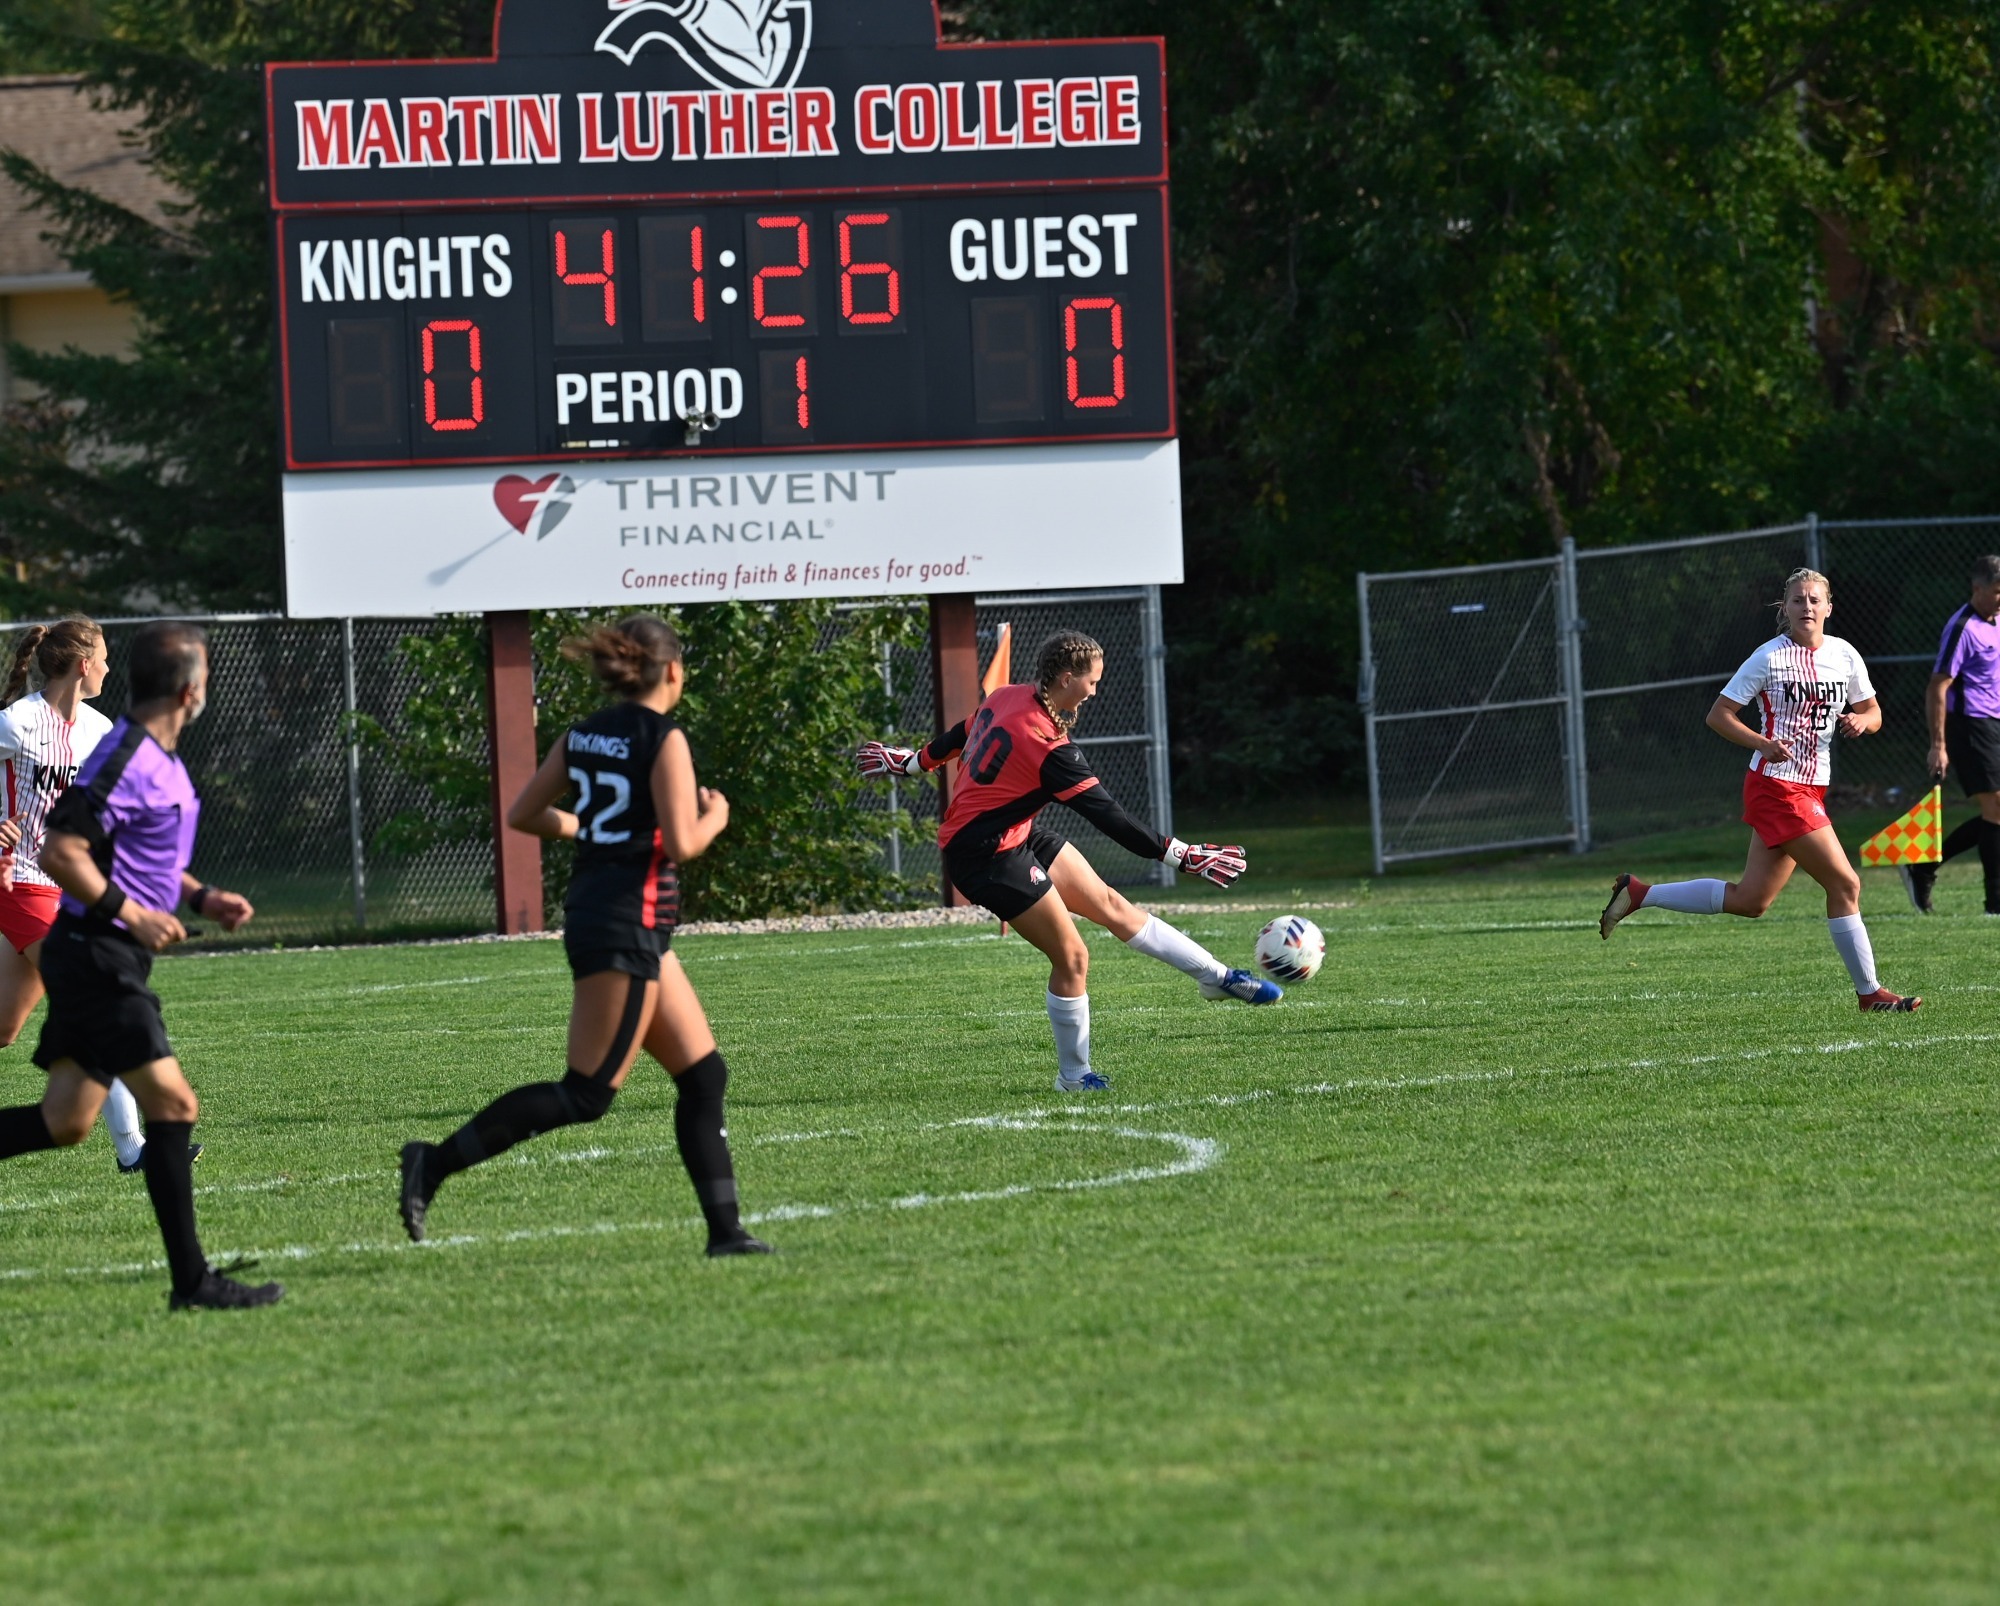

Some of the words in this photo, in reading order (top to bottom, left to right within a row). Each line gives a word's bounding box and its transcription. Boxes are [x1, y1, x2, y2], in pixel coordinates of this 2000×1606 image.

[294, 94, 561, 170] MARTIN
[577, 86, 840, 163] LUTHER
[854, 75, 1141, 155] COLLEGE
[299, 233, 513, 303] KNIGHTS
[555, 213, 899, 326] 41:26
[949, 213, 1138, 283] GUEST
[422, 319, 483, 432] 0
[1064, 297, 1125, 408] 0
[556, 367, 744, 425] PERIOD
[796, 356, 808, 429] 1
[605, 470, 897, 511] THRIVENT
[622, 568, 727, 590] Connecting
[734, 563, 777, 589] faith
[784, 563, 797, 582] &
[804, 562, 880, 586] finances
[886, 558, 914, 583] for
[32, 764, 83, 791] KNIG
